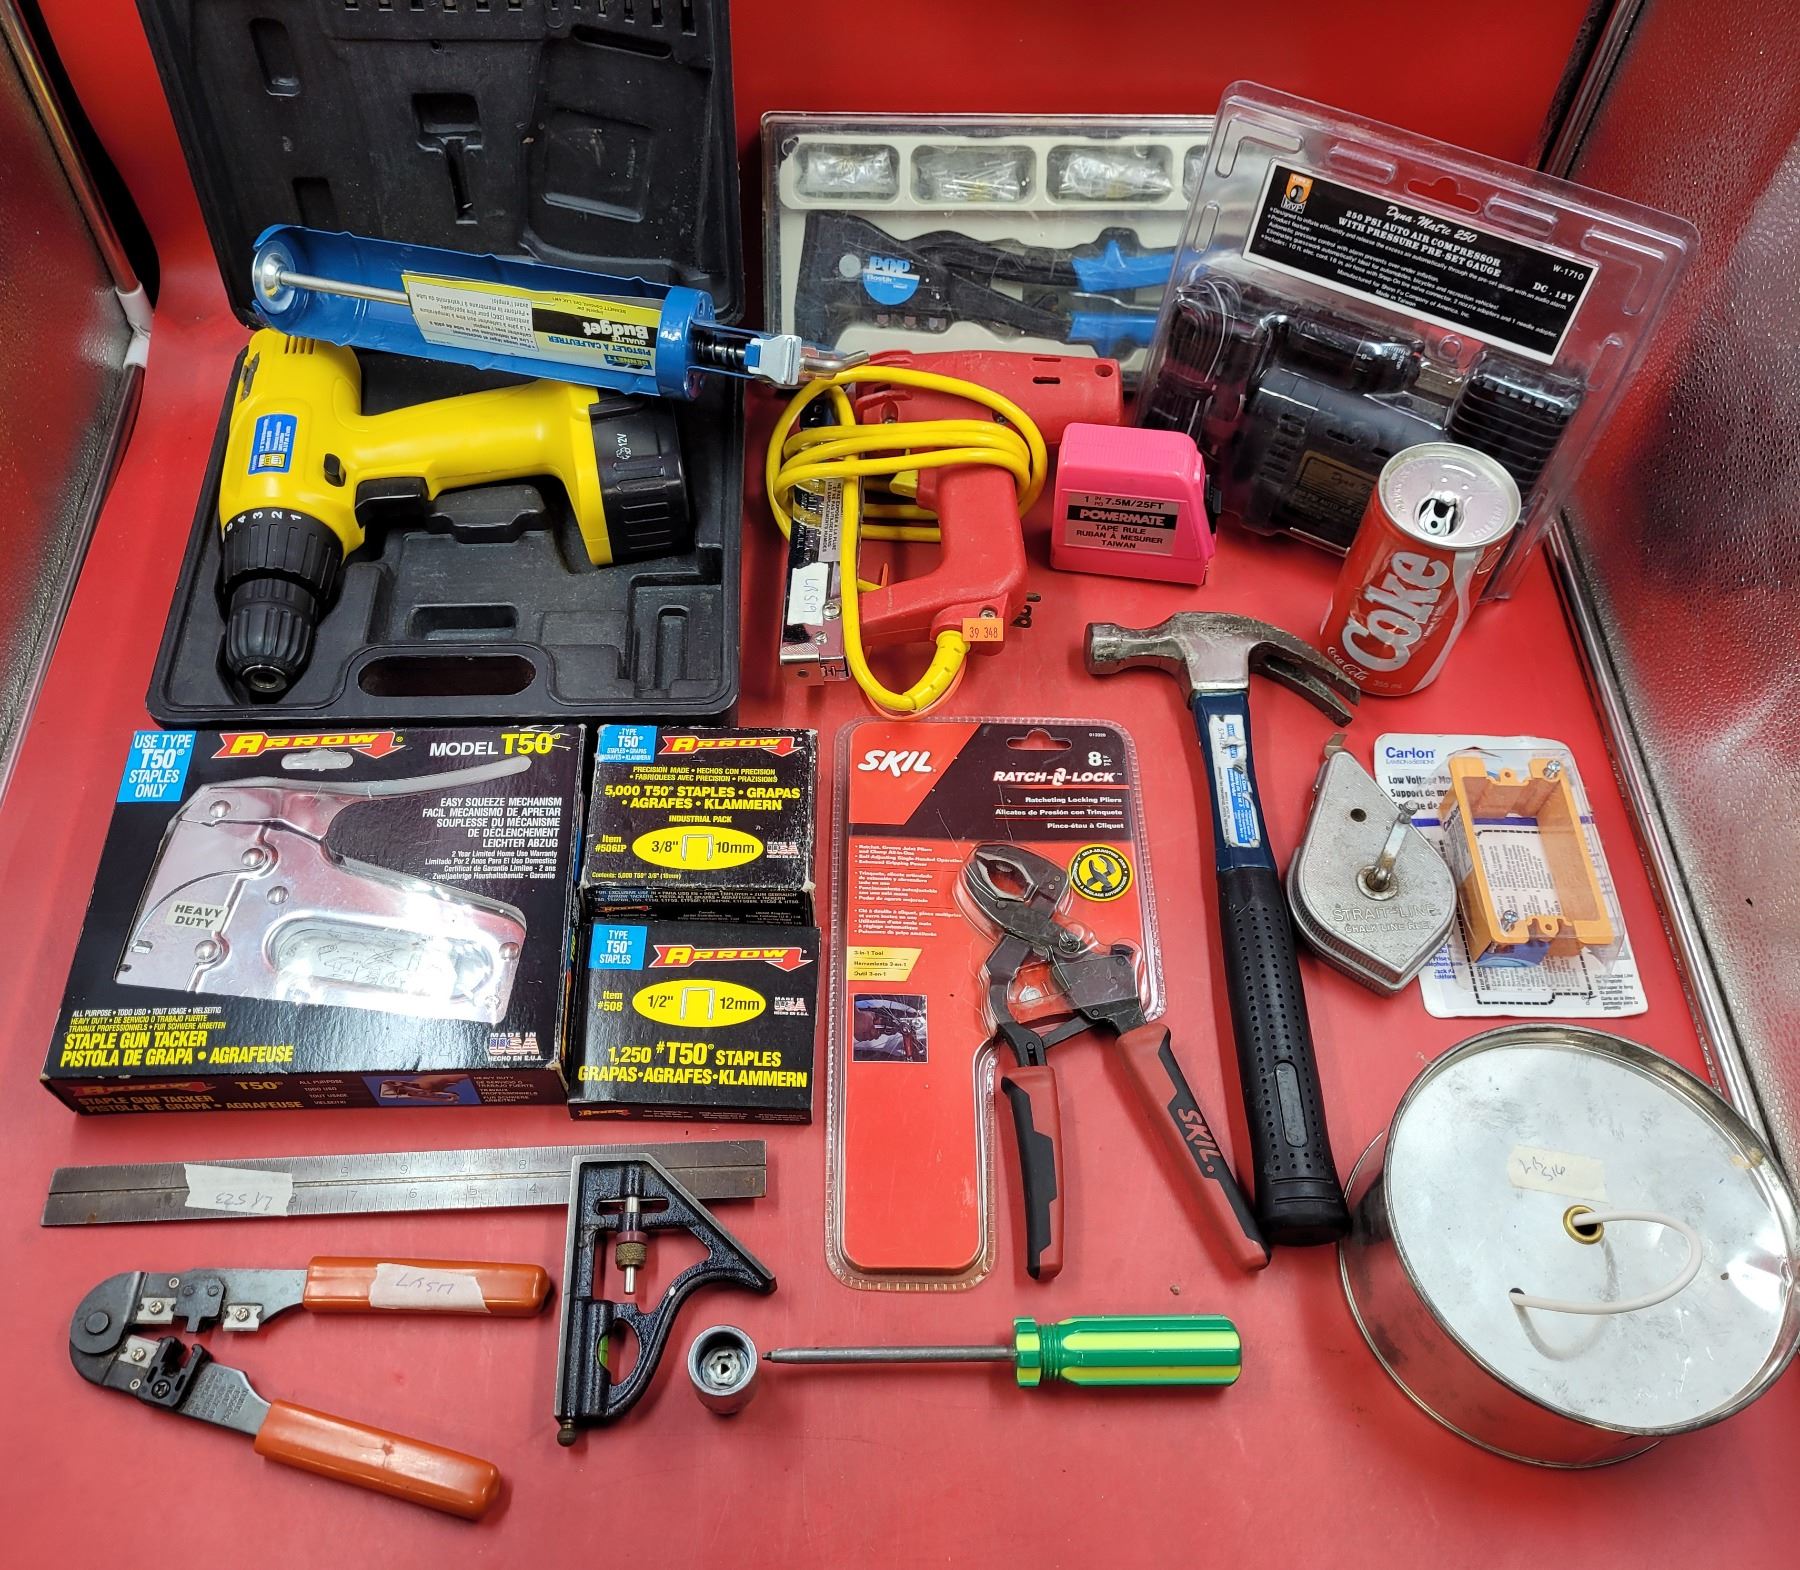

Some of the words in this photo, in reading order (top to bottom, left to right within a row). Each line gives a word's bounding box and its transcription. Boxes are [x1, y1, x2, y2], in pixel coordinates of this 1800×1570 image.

[1283, 200, 1303, 213] MVP
[1273, 208, 1296, 220] Designed
[1347, 211, 1362, 221] 250
[1365, 216, 1381, 228] PSI
[1384, 222, 1409, 237] AUTO
[1412, 232, 1429, 243] AIR
[1431, 238, 1500, 267] COMPRESSOR
[1454, 228, 1477, 244] 250
[1338, 217, 1361, 231] WITH
[1363, 225, 1419, 250] PRESSURE
[1467, 260, 1501, 277] GAUGE
[1553, 265, 1584, 281] W-1710
[1556, 290, 1574, 303] 12V
[582, 319, 649, 339] Budget
[548, 335, 601, 349] CALFEUTRER
[612, 345, 651, 356] PISTOLET
[616, 433, 628, 446] 12V
[1104, 497, 1164, 509] 7.5M/25FT
[237, 514, 246, 523] 4
[252, 511, 263, 519] 3
[271, 511, 283, 519] 2
[1079, 508, 1166, 526] POWERMATE
[1076, 530, 1106, 539] RUBAN
[1120, 534, 1163, 544] MESURER
[1122, 526, 1146, 535] RULE
[1101, 540, 1136, 549] TAIWAN
[1342, 551, 1450, 671] Coke
[969, 627, 979, 638] 39
[984, 627, 998, 638] 348
[134, 734, 161, 748] USE
[162, 734, 192, 748] TYPE
[229, 733, 380, 754] ARROW
[671, 737, 782, 752] ARROW
[429, 741, 499, 757] MODEL
[1386, 747, 1434, 758] Carlon
[857, 749, 932, 777] SKIL
[1088, 751, 1102, 766] 8
[129, 769, 180, 783] STAPLES
[1388, 776, 1404, 784] Low
[135, 783, 167, 798] ONLY
[604, 785, 640, 797] 5,000
[677, 786, 735, 798] STAPLES
[746, 787, 801, 799] GRAPAS
[1390, 789, 1423, 798] Support
[1425, 789, 1435, 797] de
[440, 797, 463, 807] EASY
[465, 797, 506, 807] SQUEEZE
[508, 797, 562, 807] MECHANISM
[630, 798, 693, 809] AGRAFES
[704, 799, 782, 810] KLAMMERN
[1068, 797, 1098, 805] Locking
[422, 808, 446, 818] FACIL
[450, 808, 503, 818] MECANISMO
[506, 807, 520, 817] DE
[521, 807, 561, 817] APRETAR
[995, 808, 1026, 816] Alicates
[436, 818, 488, 828] SOUPLESSE
[491, 818, 505, 828] DU
[507, 816, 560, 828] MÉCANISME
[669, 815, 711, 823] INDUSTRIAL
[712, 815, 732, 823] PACK
[467, 828, 481, 838] DE
[483, 827, 560, 838] DÉCLENCHEMENT
[602, 834, 622, 843] Item
[482, 839, 526, 848] LEICHTER
[527, 838, 558, 848] ABZUG
[651, 840, 679, 853] 3/8"
[716, 841, 755, 854] 10mm
[530, 851, 557, 859] Warranty
[174, 904, 224, 918] HEAVY
[1333, 904, 1441, 921] STRAIT-LINE
[174, 915, 215, 928] DUTY
[1344, 924, 1376, 933] CHALK
[1381, 923, 1405, 931] LINE
[608, 930, 628, 940] TYPE
[599, 953, 631, 964] STAPLES
[664, 946, 788, 964] ARROW
[602, 990, 623, 999] Item
[597, 1000, 623, 1012] #508
[648, 995, 674, 1008] 1/2"
[720, 997, 760, 1011] 12mm
[85, 1009, 112, 1017] PURPOSE
[64, 1032, 116, 1050] STAPLE
[120, 1031, 151, 1048] GUN
[154, 1030, 208, 1047] TACKER
[489, 1037, 539, 1055] USA
[60, 1050, 120, 1067] PISTOLA
[122, 1049, 143, 1066] DE
[145, 1048, 192, 1065] GRAPA
[209, 1046, 294, 1064] AGRAFEUSE
[608, 1046, 652, 1065] 1,250
[715, 1050, 781, 1067] STAPLES
[578, 1066, 638, 1082] GRAPAS
[642, 1067, 712, 1084] AGRAFES
[718, 1070, 807, 1087] KLAMMERN
[1178, 1108, 1220, 1162] SKIL
